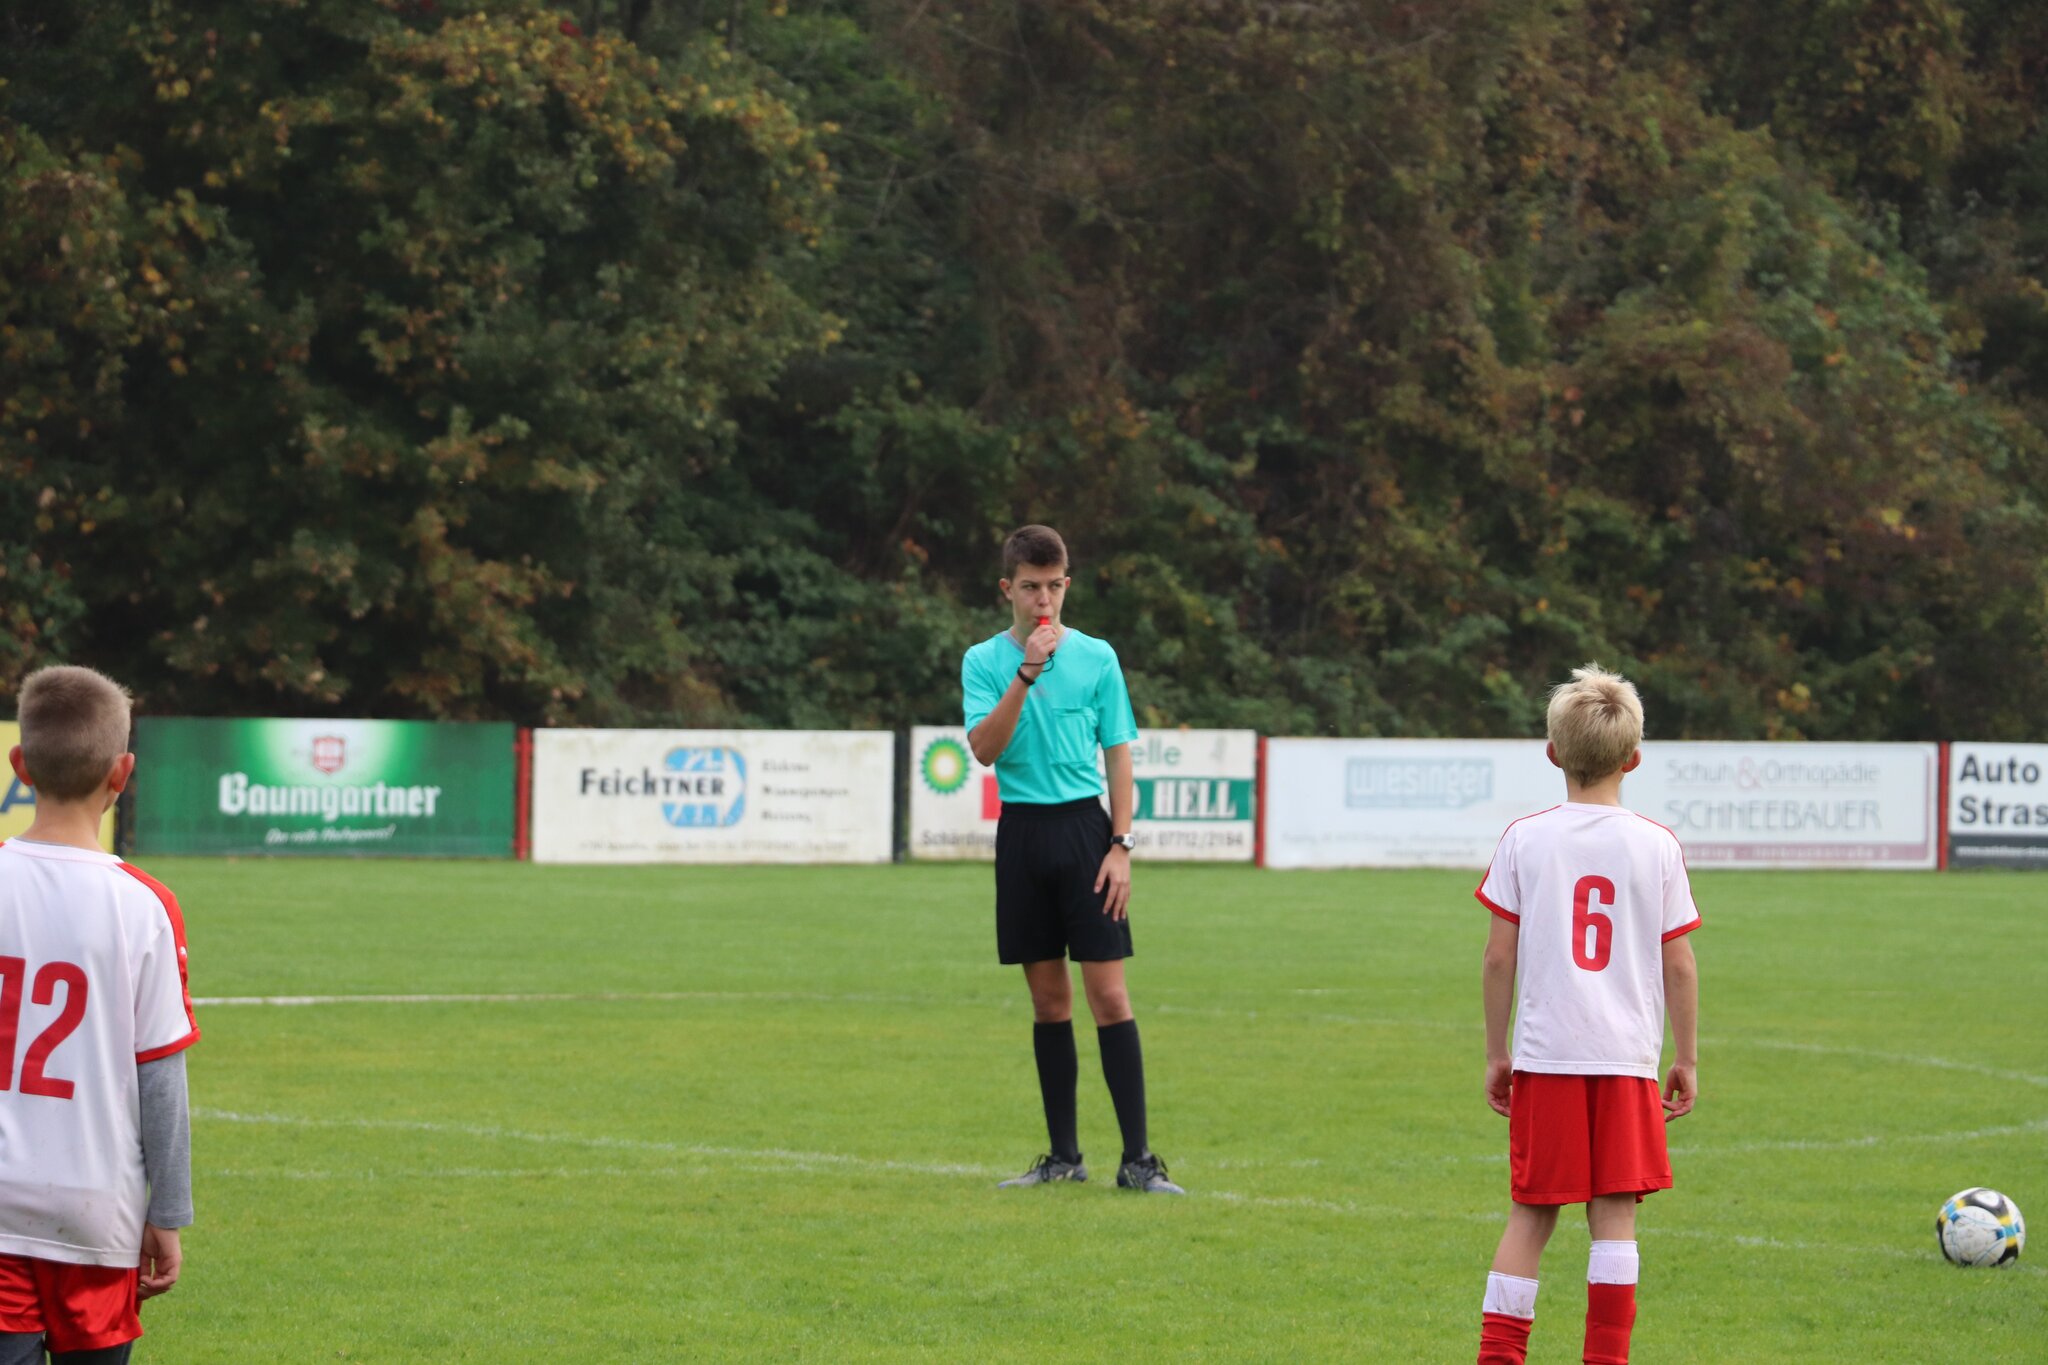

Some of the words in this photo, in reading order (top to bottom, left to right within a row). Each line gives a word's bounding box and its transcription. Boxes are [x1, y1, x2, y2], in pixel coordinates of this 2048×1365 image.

[1130, 738, 1181, 765] elle
[1960, 753, 2040, 784] Auto
[218, 771, 442, 821] Baumgartner
[1153, 779, 1237, 819] HELL
[1350, 761, 1490, 806] wiesinger
[1665, 799, 1881, 831] SCHNEEBAUER
[1959, 795, 2048, 826] Stras
[1572, 875, 1615, 972] 6
[0, 955, 88, 1100] 12
